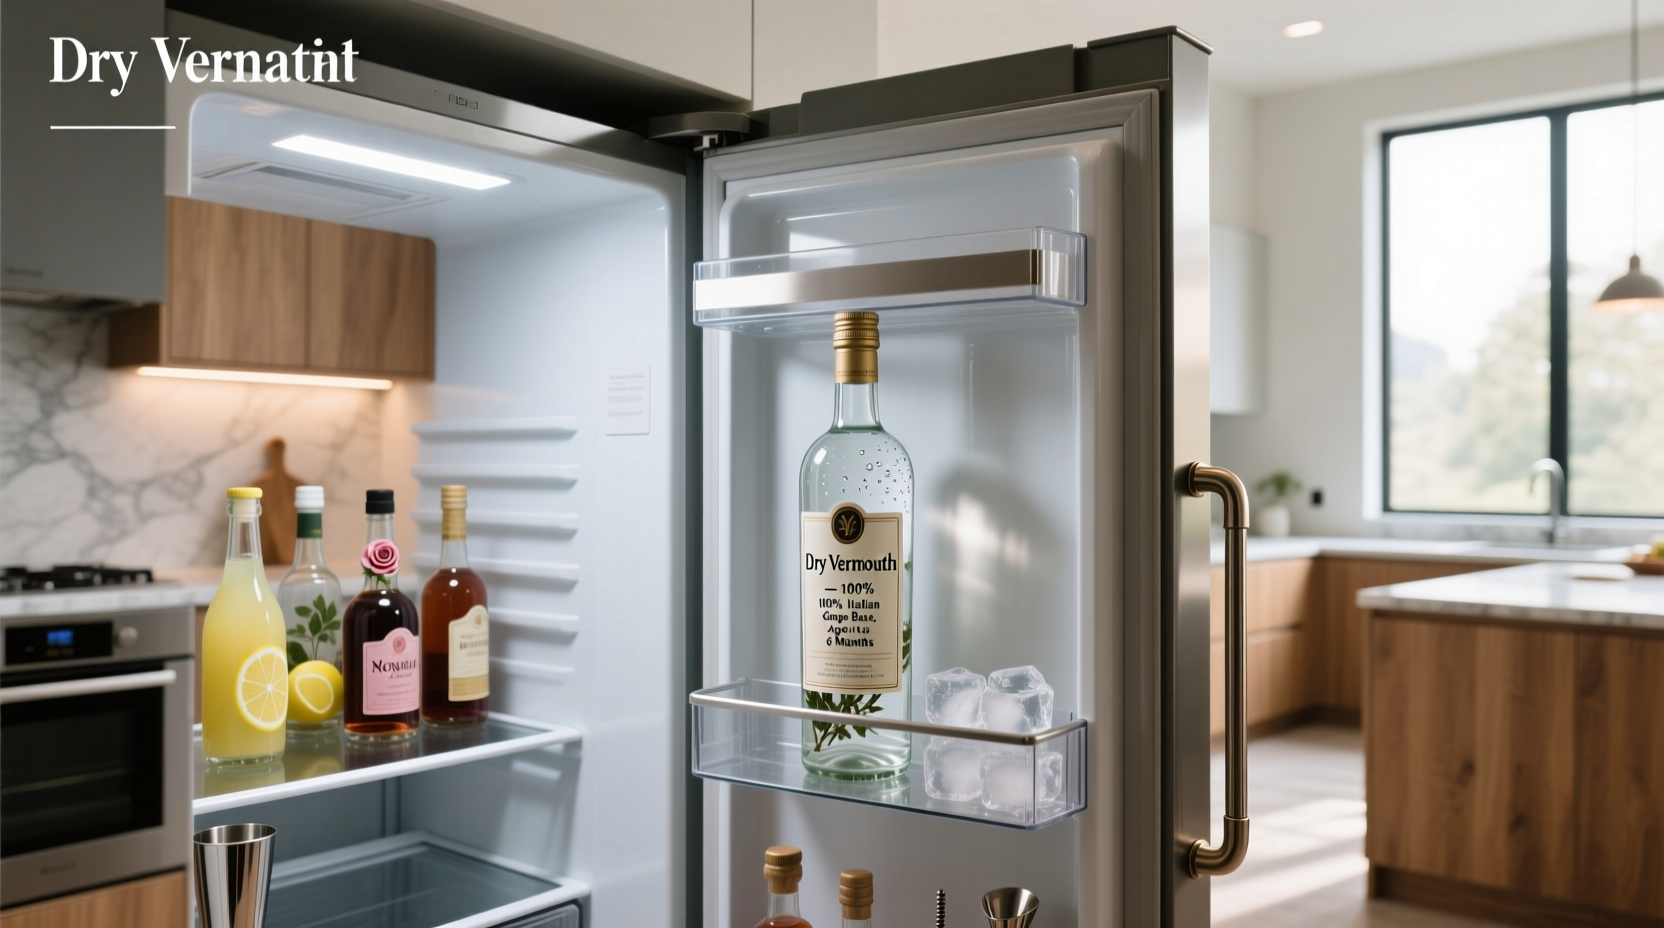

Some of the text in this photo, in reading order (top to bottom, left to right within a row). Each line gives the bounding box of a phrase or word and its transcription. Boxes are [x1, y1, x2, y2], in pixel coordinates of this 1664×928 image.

[805, 552, 897, 576] Dry Vermouth
[841, 582, 875, 595] 100%
